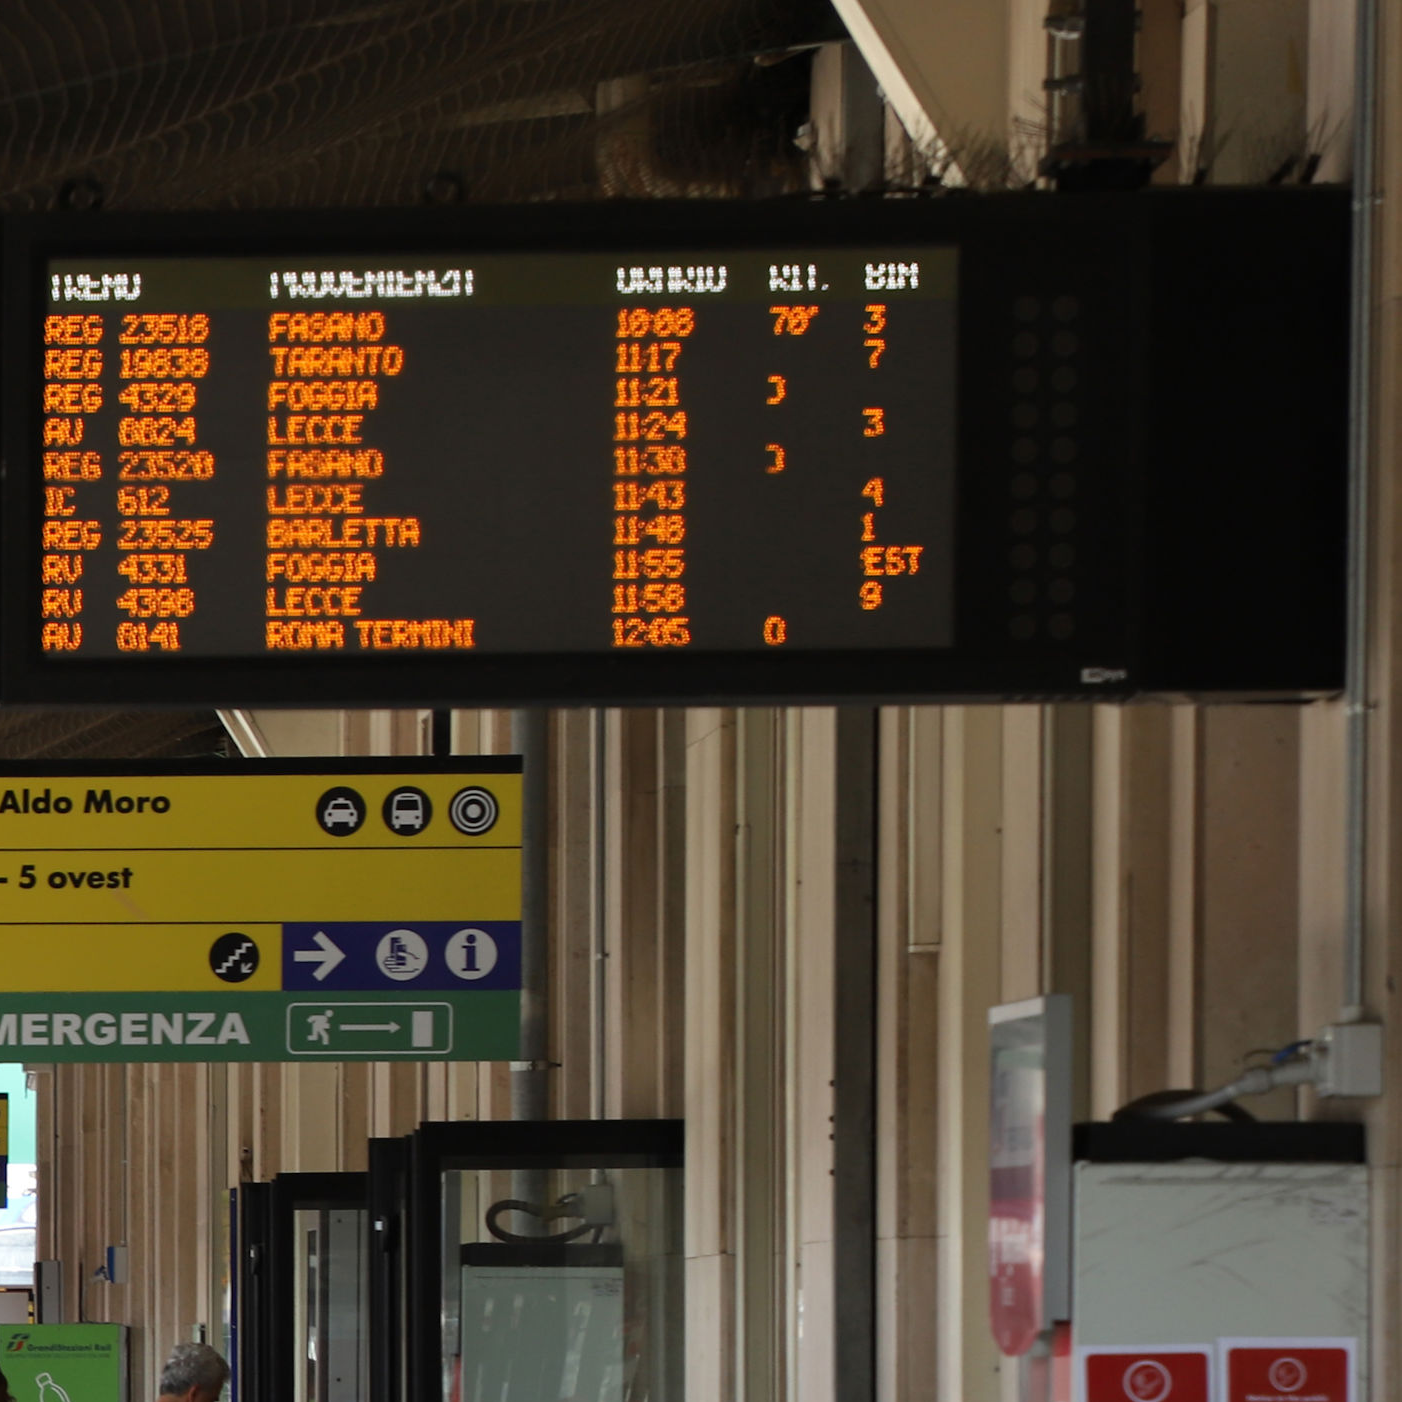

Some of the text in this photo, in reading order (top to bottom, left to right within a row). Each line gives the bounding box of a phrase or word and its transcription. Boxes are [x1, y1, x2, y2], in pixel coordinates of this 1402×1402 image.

[44, 314, 103, 345] REG
[268, 311, 385, 342] FASANO
[863, 304, 886, 334] 3
[44, 348, 103, 379] REG
[269, 345, 404, 377] TARANTO
[616, 341, 682, 373] 11:17
[864, 338, 886, 368] 7
[44, 383, 103, 413] REG
[268, 380, 379, 411] FOGGIA
[614, 376, 679, 407] 11:21
[267, 414, 364, 445] LECCE
[614, 411, 687, 441] 11:24
[863, 408, 885, 437] 3
[43, 451, 102, 481] REG
[267, 448, 384, 479] FASANO
[44, 486, 76, 516] IC
[117, 485, 170, 516] 612
[266, 483, 364, 515] LECCE
[862, 478, 884, 507] 4
[43, 520, 102, 550] REG
[266, 517, 421, 549] BARLETTA
[861, 512, 875, 541] 1
[117, 553, 188, 584] 4331
[266, 552, 377, 582] FOGGIA
[860, 545, 924, 576] EST
[266, 586, 363, 617] LECCE
[266, 620, 345, 650] ROMA
[353, 619, 475, 649] TERMINI
[0, 788, 75, 816] Aldo
[82, 790, 172, 815] Moro
[19, 865, 36, 889] 5
[47, 865, 133, 890] ovest
